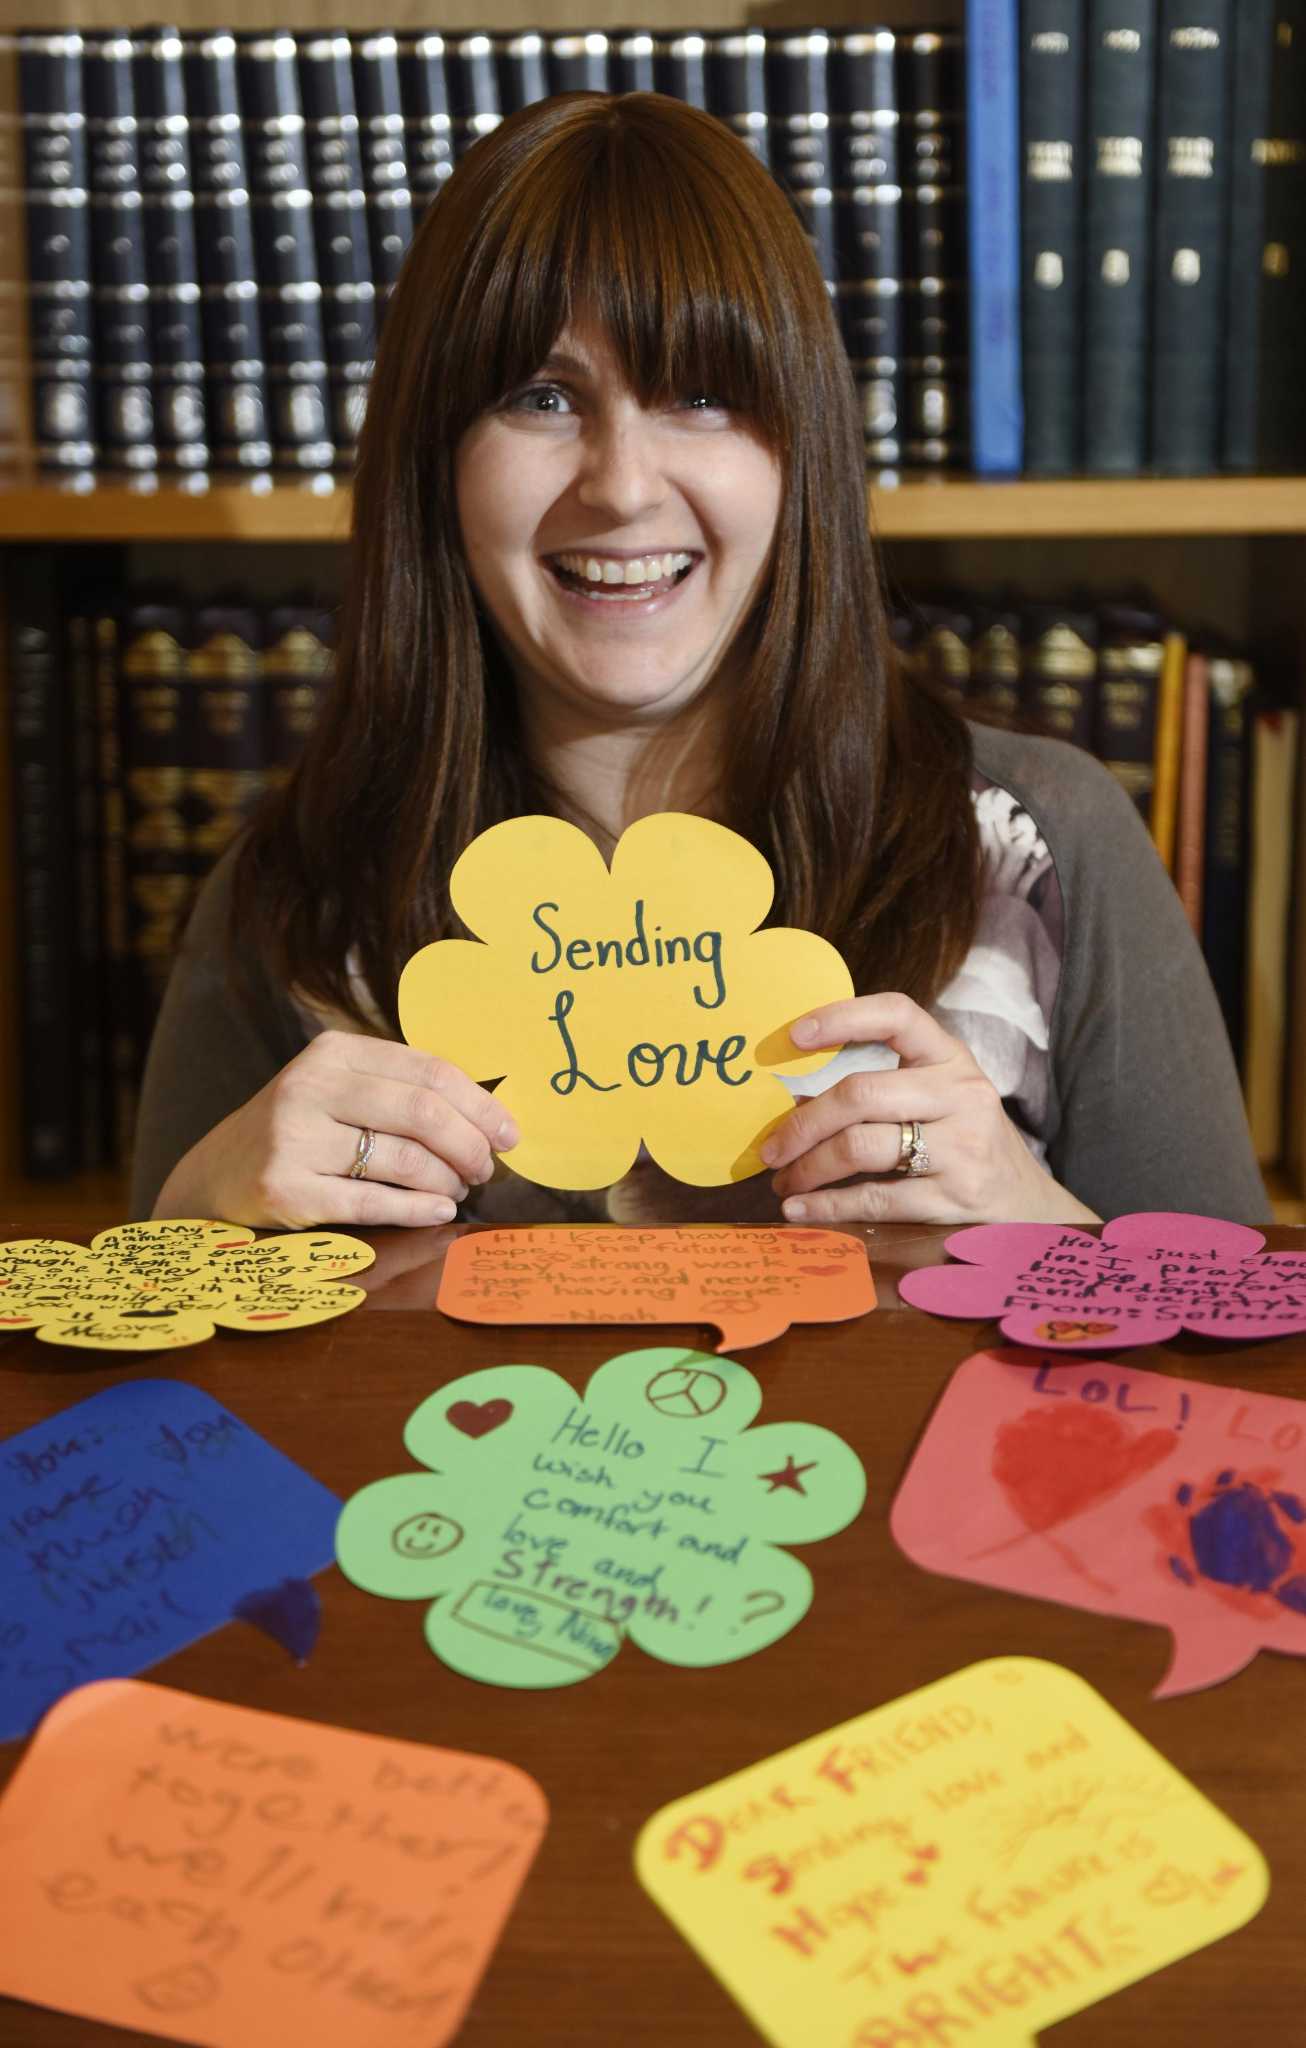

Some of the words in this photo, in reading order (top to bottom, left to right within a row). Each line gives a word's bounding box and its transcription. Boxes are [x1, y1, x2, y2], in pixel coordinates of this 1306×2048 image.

[530, 898, 726, 1010] Sending
[547, 989, 753, 1096] Love
[570, 1231, 657, 1244] Keep
[674, 1231, 778, 1244] having
[5, 1247, 76, 1255] know
[208, 1245, 281, 1257] going
[655, 1241, 748, 1254] future
[760, 1245, 782, 1254] is
[1146, 1248, 1220, 1260] just
[203, 1255, 289, 1266] times
[309, 1252, 369, 1261] but
[469, 1258, 552, 1274] Stay
[692, 1255, 788, 1269] work
[106, 1267, 201, 1276] happy
[222, 1264, 317, 1277] things
[1096, 1255, 1133, 1271] I
[1160, 1264, 1260, 1280] pray
[208, 1275, 276, 1283] talk
[632, 1271, 689, 1285] and
[553, 1284, 675, 1300] having
[551, 1406, 646, 1459] Hello
[678, 1435, 728, 1479] I
[532, 1453, 616, 1489] wish
[632, 1489, 716, 1514] you
[678, 1535, 749, 1566] and
[593, 1556, 666, 1596] and
